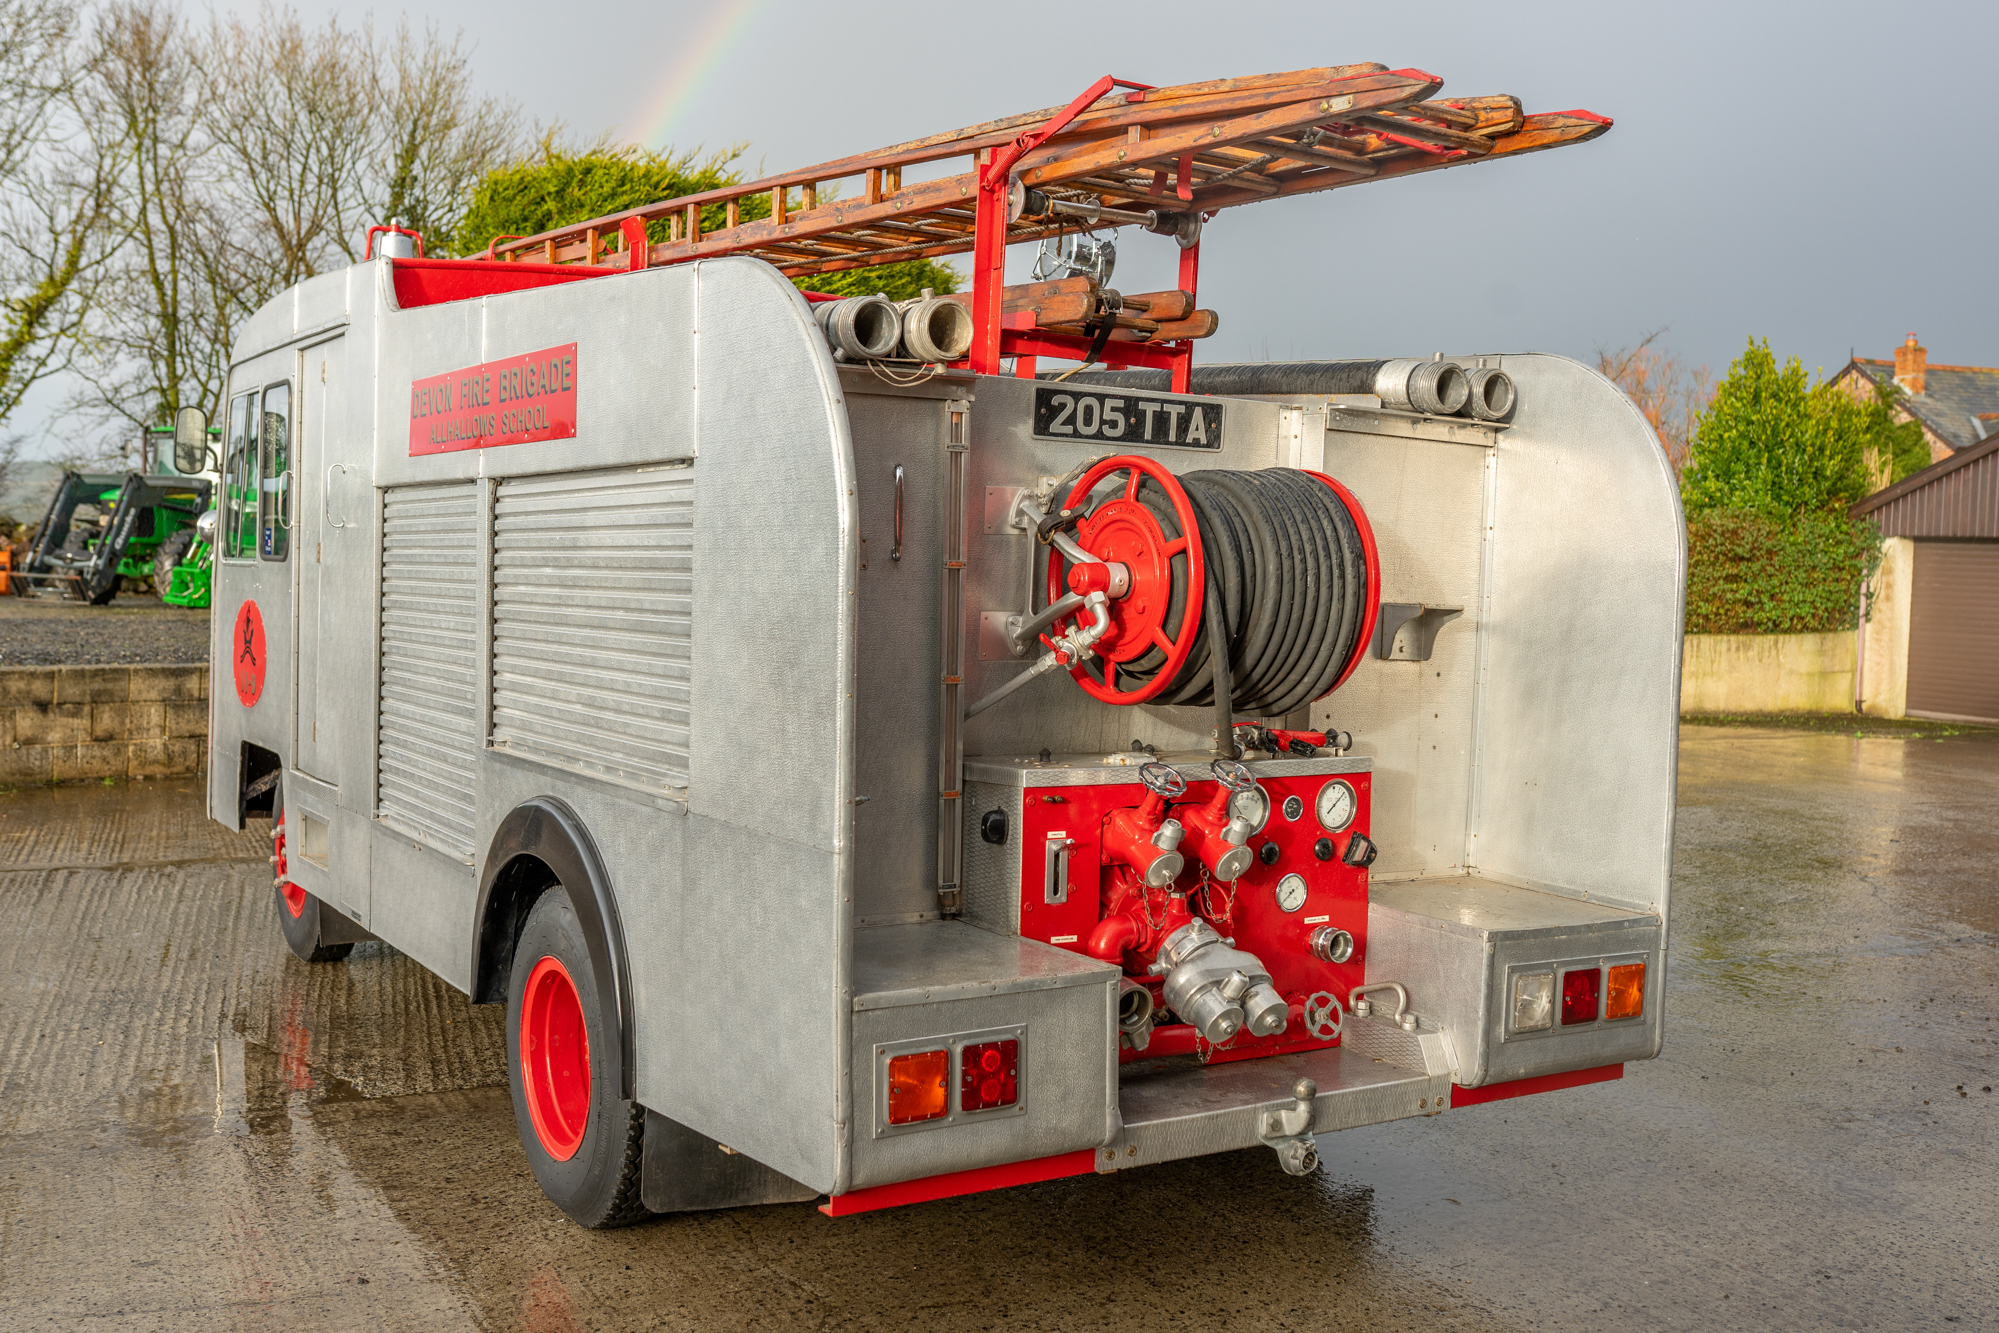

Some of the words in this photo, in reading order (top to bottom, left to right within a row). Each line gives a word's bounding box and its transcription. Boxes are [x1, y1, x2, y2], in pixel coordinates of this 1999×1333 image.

[412, 381, 453, 419] DEVON
[460, 373, 491, 410] FIRE
[499, 355, 572, 403] BRIGADE
[429, 412, 495, 445] ALLHALLOWS
[501, 404, 549, 435] SCHOOL
[1050, 394, 1125, 437] 205
[1139, 401, 1207, 444] TTA
